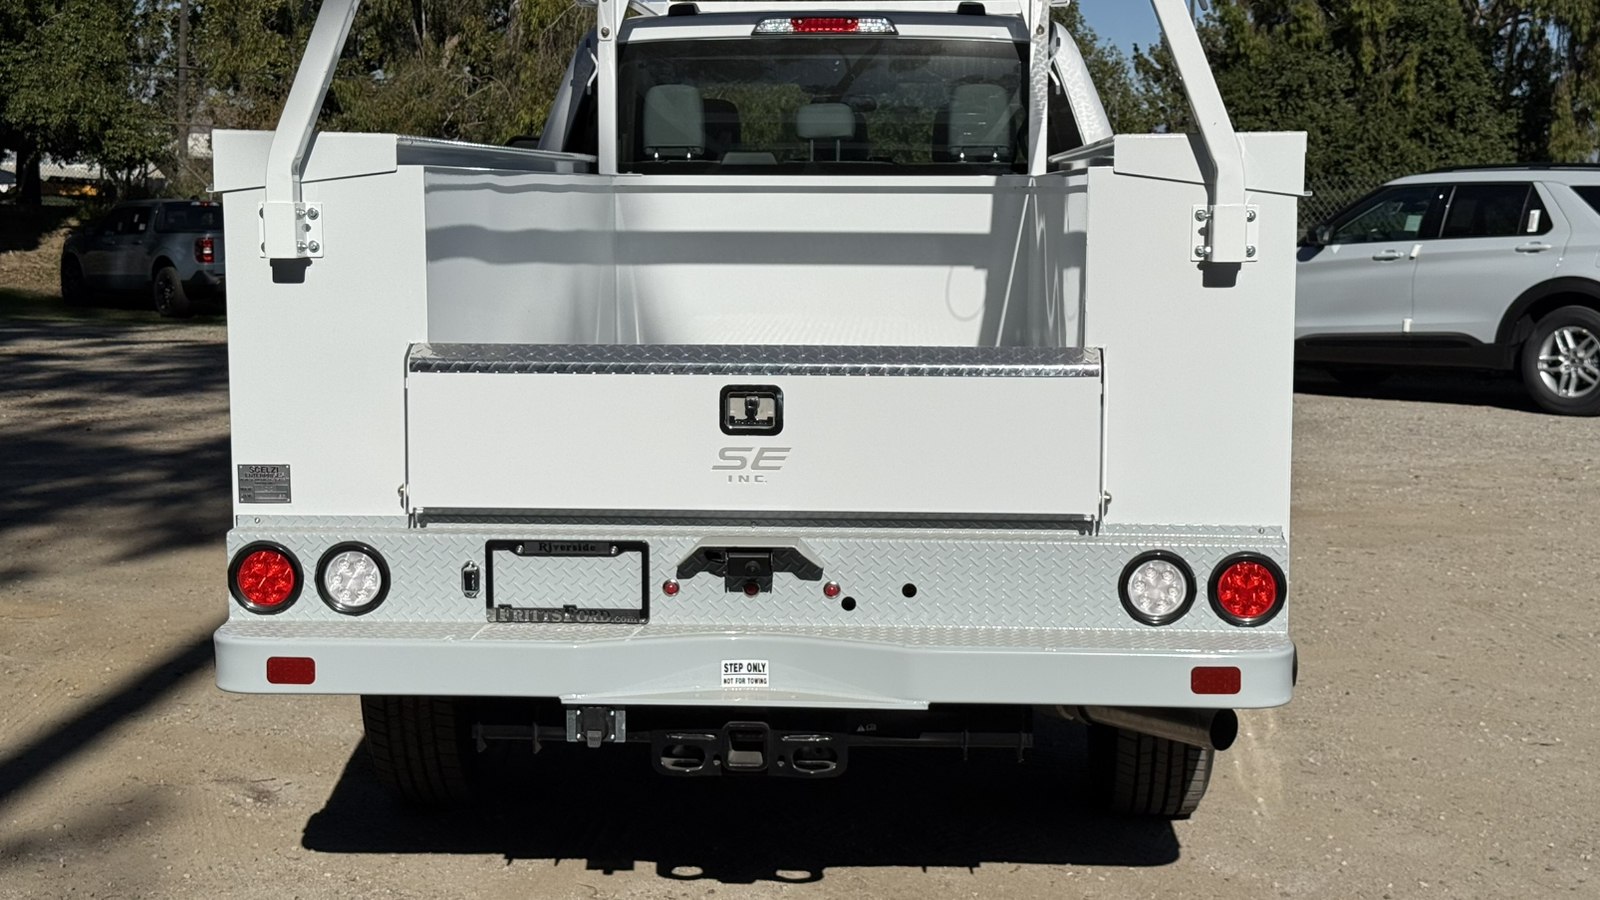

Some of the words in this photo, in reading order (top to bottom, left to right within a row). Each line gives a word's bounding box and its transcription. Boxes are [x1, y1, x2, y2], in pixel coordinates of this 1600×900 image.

[711, 447, 792, 471] SE
[728, 475, 768, 483] INC.
[538, 542, 597, 553] Riverside
[723, 662, 744, 673] STEP
[746, 662, 767, 673] ONLY
[723, 677, 734, 685] NOT
[735, 677, 746, 685] FOR
[747, 677, 768, 685] TOWING
